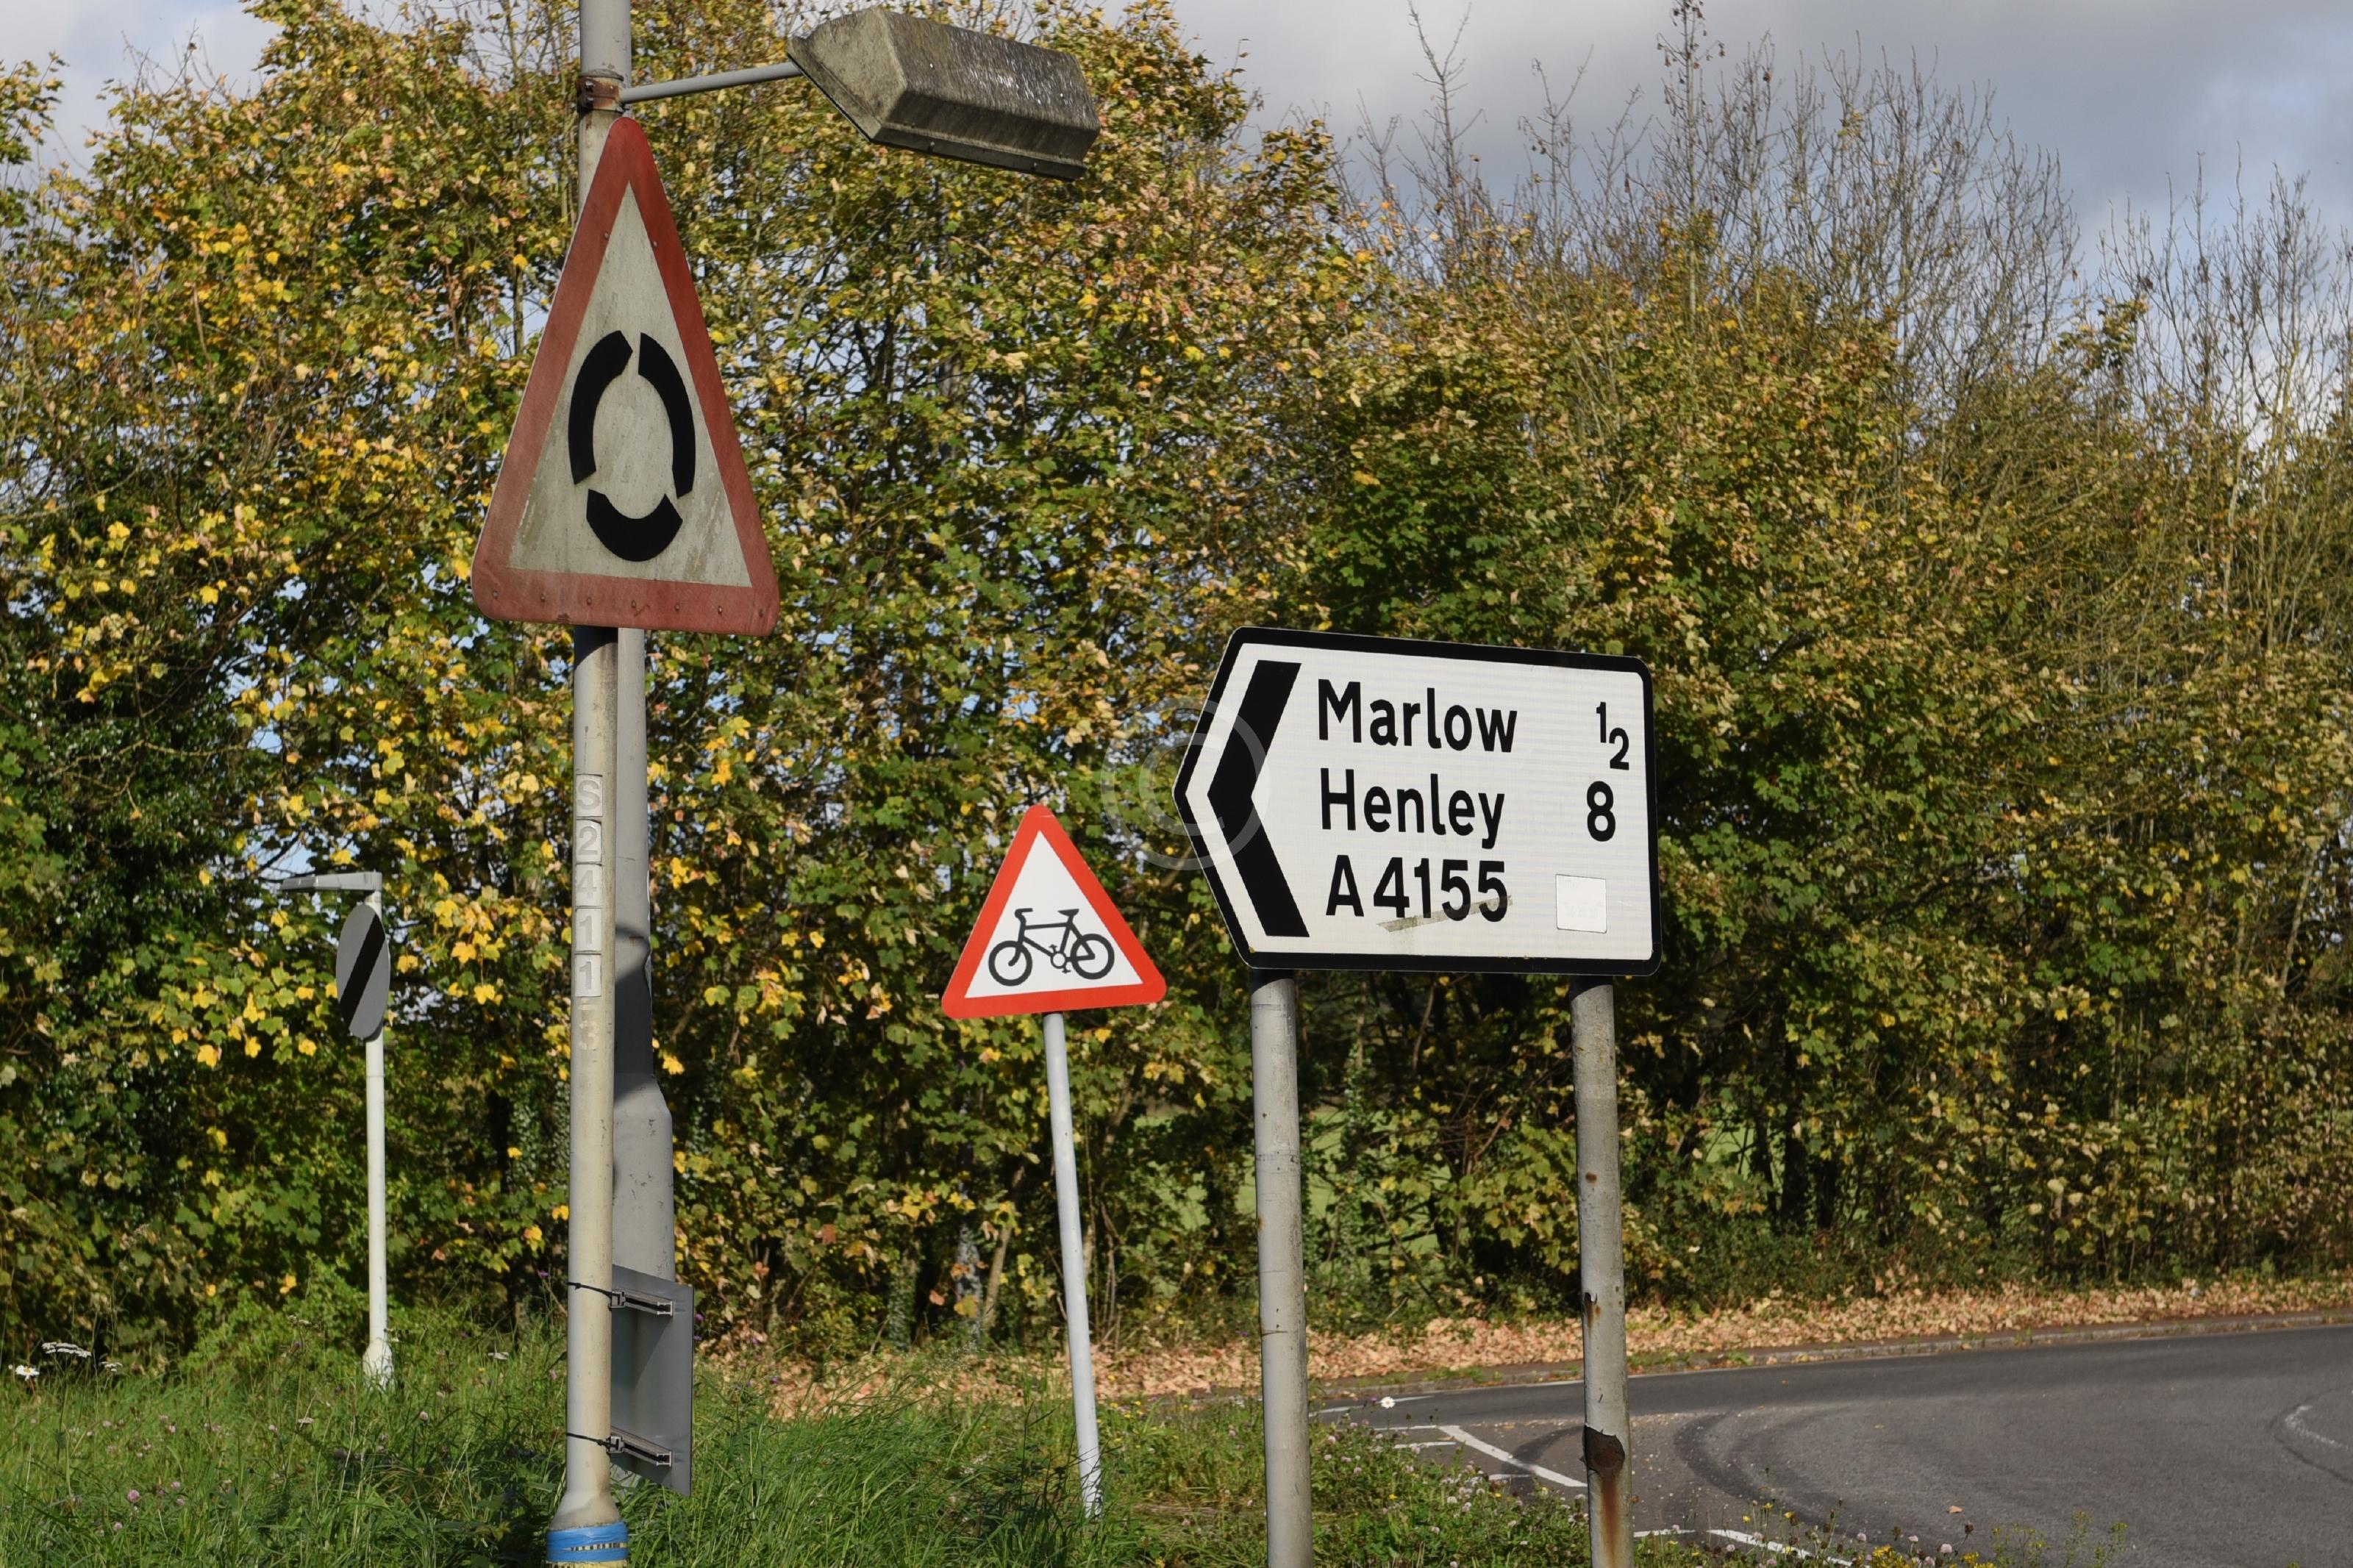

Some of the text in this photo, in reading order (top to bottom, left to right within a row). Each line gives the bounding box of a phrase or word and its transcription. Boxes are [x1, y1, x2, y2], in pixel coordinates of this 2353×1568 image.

[1318, 679, 1518, 753] Marlow
[1320, 767, 1616, 850] Henley 8
[1325, 854, 1508, 923] A4155
